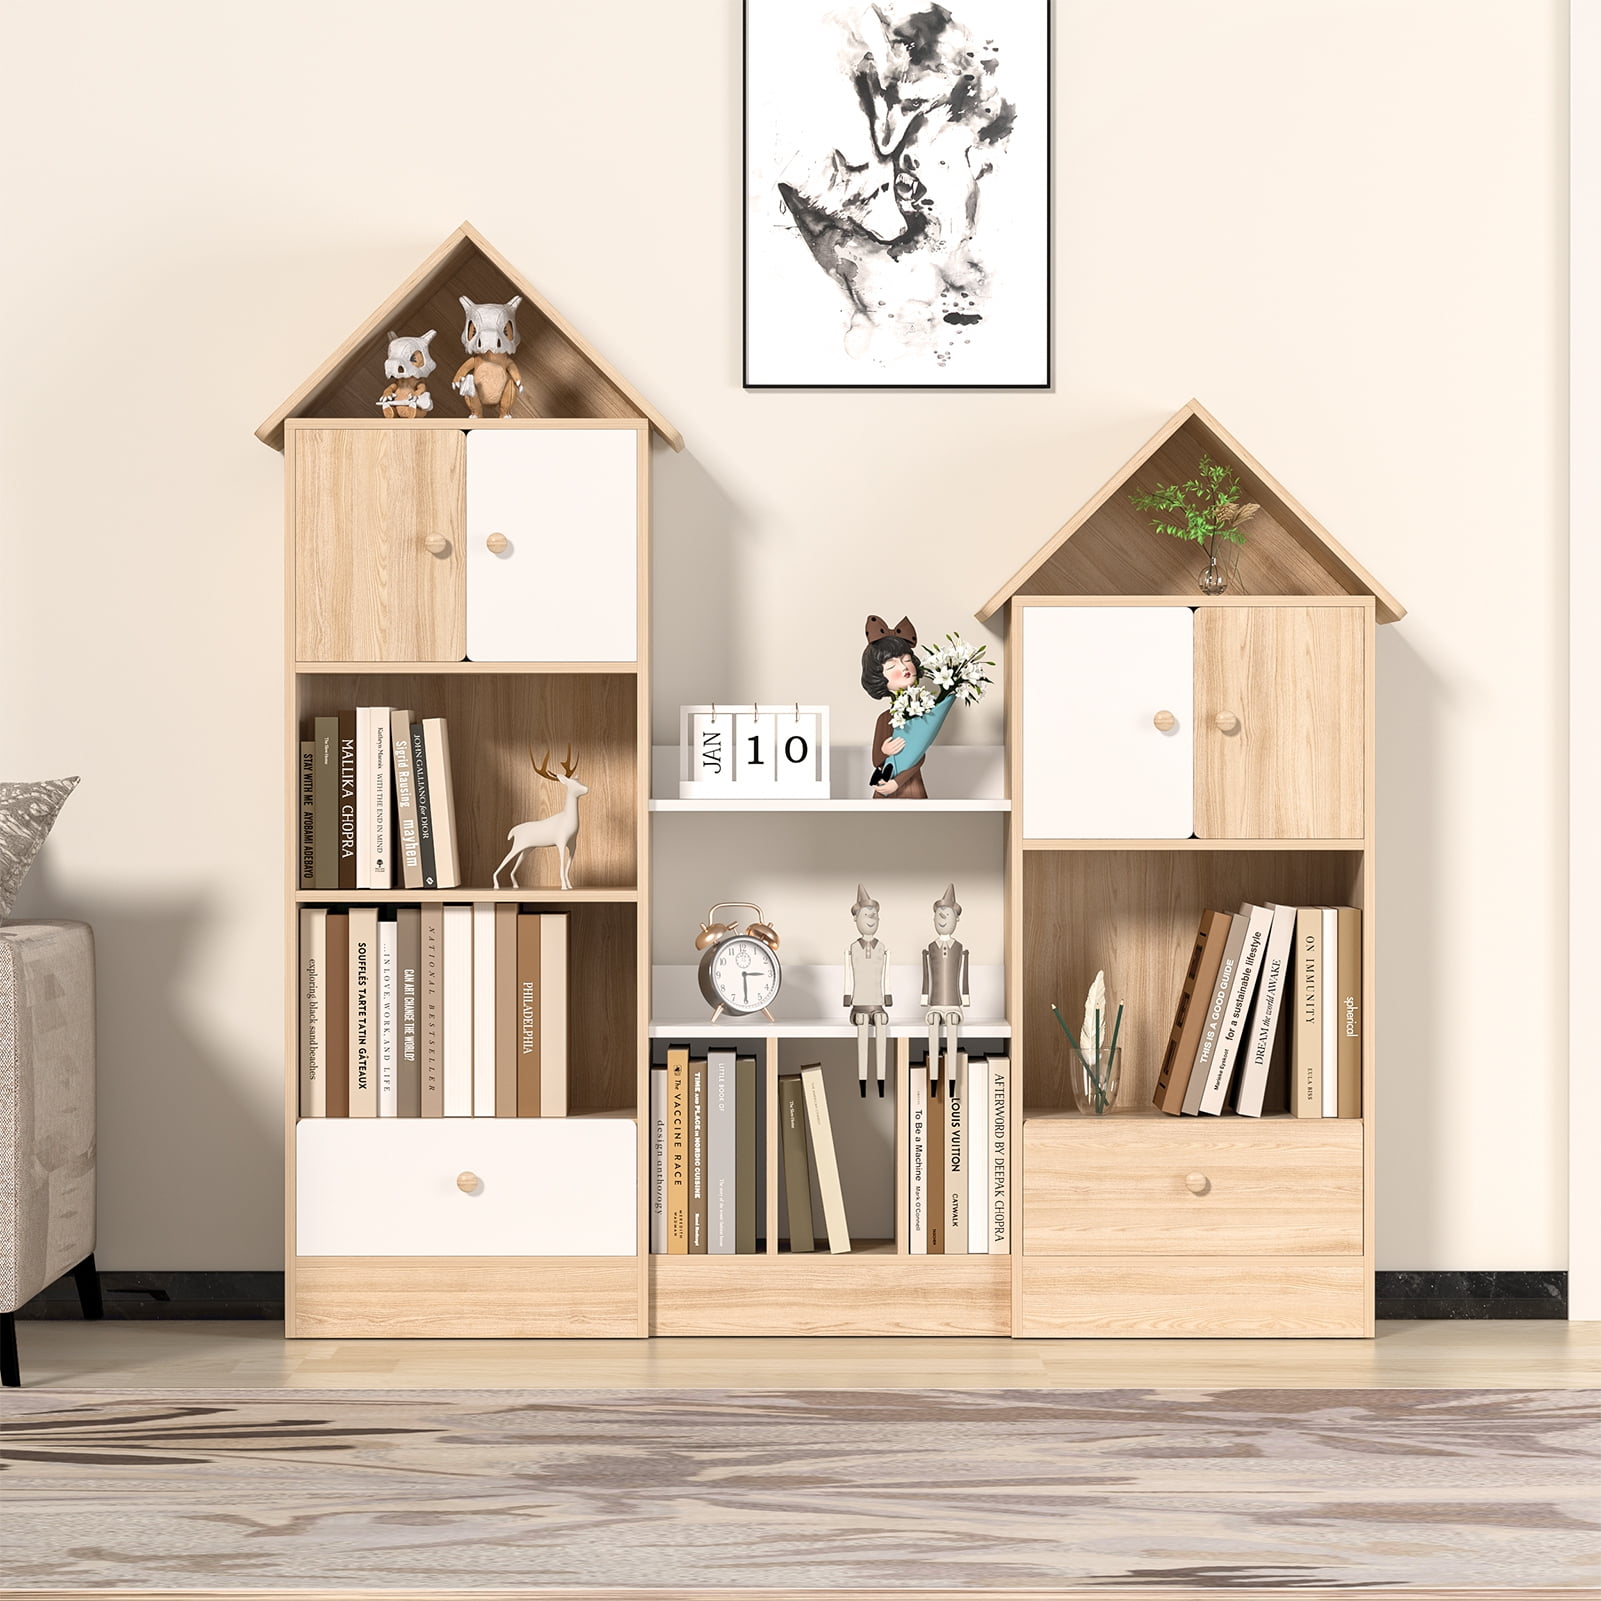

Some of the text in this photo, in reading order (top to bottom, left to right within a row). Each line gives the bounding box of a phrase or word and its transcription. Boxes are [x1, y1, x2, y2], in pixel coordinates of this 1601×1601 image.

[376, 727, 384, 749] Kathryn
[395, 740, 411, 808] Sigrid Rausing
[702, 731, 722, 774] JAN
[748, 735, 808, 765] 1 0
[303, 753, 313, 806] STAY WITH ME
[341, 739, 354, 858] MALLIKA CHOPRA
[413, 734, 429, 839] JOHN GALLIANO for DIOR
[303, 811, 314, 879] AYOBAMI ADEBAYO
[376, 824, 383, 833] IN
[402, 819, 418, 867] mayhem
[358, 942, 369, 1090] SOUFFLÉS TARTE TATIN GÂTEAUX
[403, 969, 415, 1062] CAN ART CHANGE THE WORLD?
[428, 926, 436, 1092] NATIONAL BESTSELLER
[1199, 959, 1235, 1064] THIS IS A GOOD GUIDE
[1225, 1027, 1235, 1041] for
[1232, 967, 1252, 1019] sustainable
[1245, 931, 1262, 967] lifestyle
[1254, 959, 1281, 1065] DREAM the world AWAKE
[1305, 935, 1315, 1025] ON IMMUNITY
[1344, 996, 1358, 1037] spherical
[306, 958, 319, 1080] exploring black sand beaches
[522, 981, 534, 1055] PHILADELPHIA
[383, 1067, 391, 1093] LIFE
[718, 1103, 725, 1112] OF
[914, 1109, 922, 1120] To
[674, 1079, 682, 1186] The VACCINE RACE
[914, 1122, 922, 1134] Be
[915, 1144, 923, 1181] Machine
[951, 1097, 961, 1172] LOUIS VUITTON
[994, 1073, 1005, 1242] AFTERWORD BY DEEPAK CHOPRA
[655, 1120, 665, 1216] design anthology
